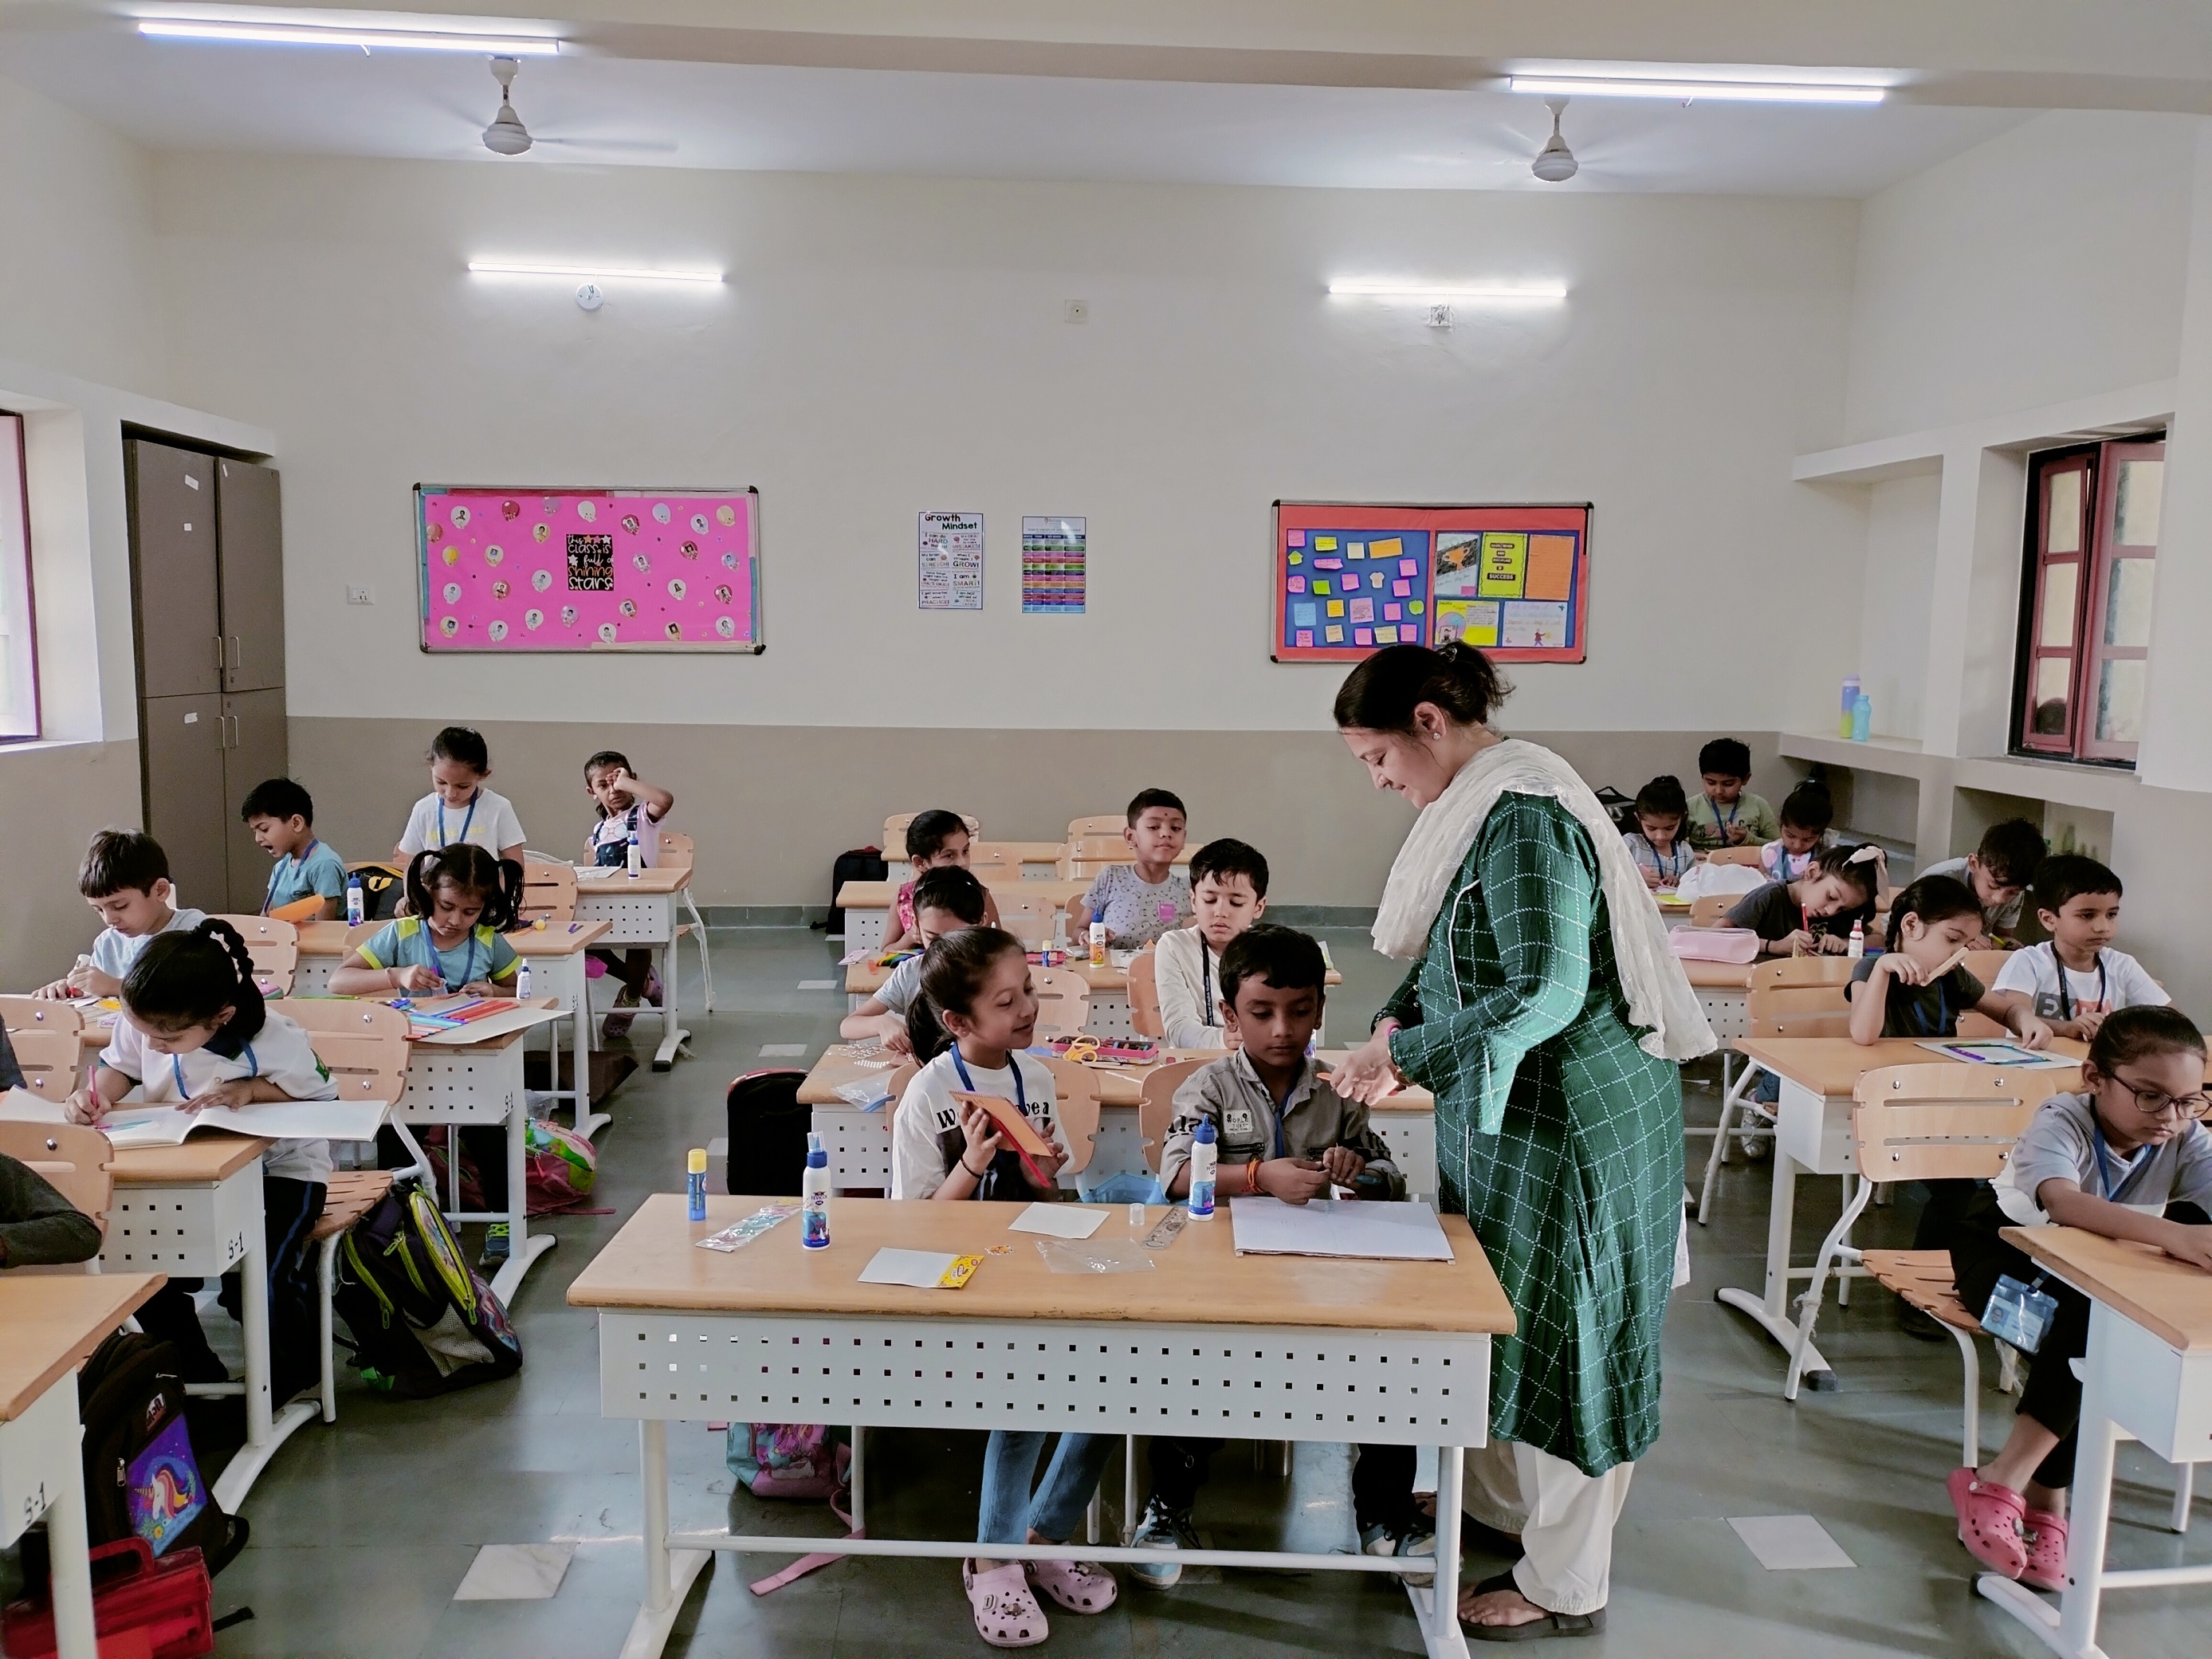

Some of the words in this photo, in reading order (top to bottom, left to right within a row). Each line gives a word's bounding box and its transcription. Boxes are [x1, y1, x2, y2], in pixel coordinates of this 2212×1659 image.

[925, 513, 961, 522] Growth
[942, 521, 977, 530] Mindset
[567, 534, 584, 544] this
[568, 544, 599, 554] class
[603, 544, 611, 554] is
[583, 553, 603, 568] full
[568, 566, 613, 577] shining
[568, 576, 613, 591] stars
[228, 1231, 244, 1260] S-1
[24, 1480, 46, 1525] S-1
